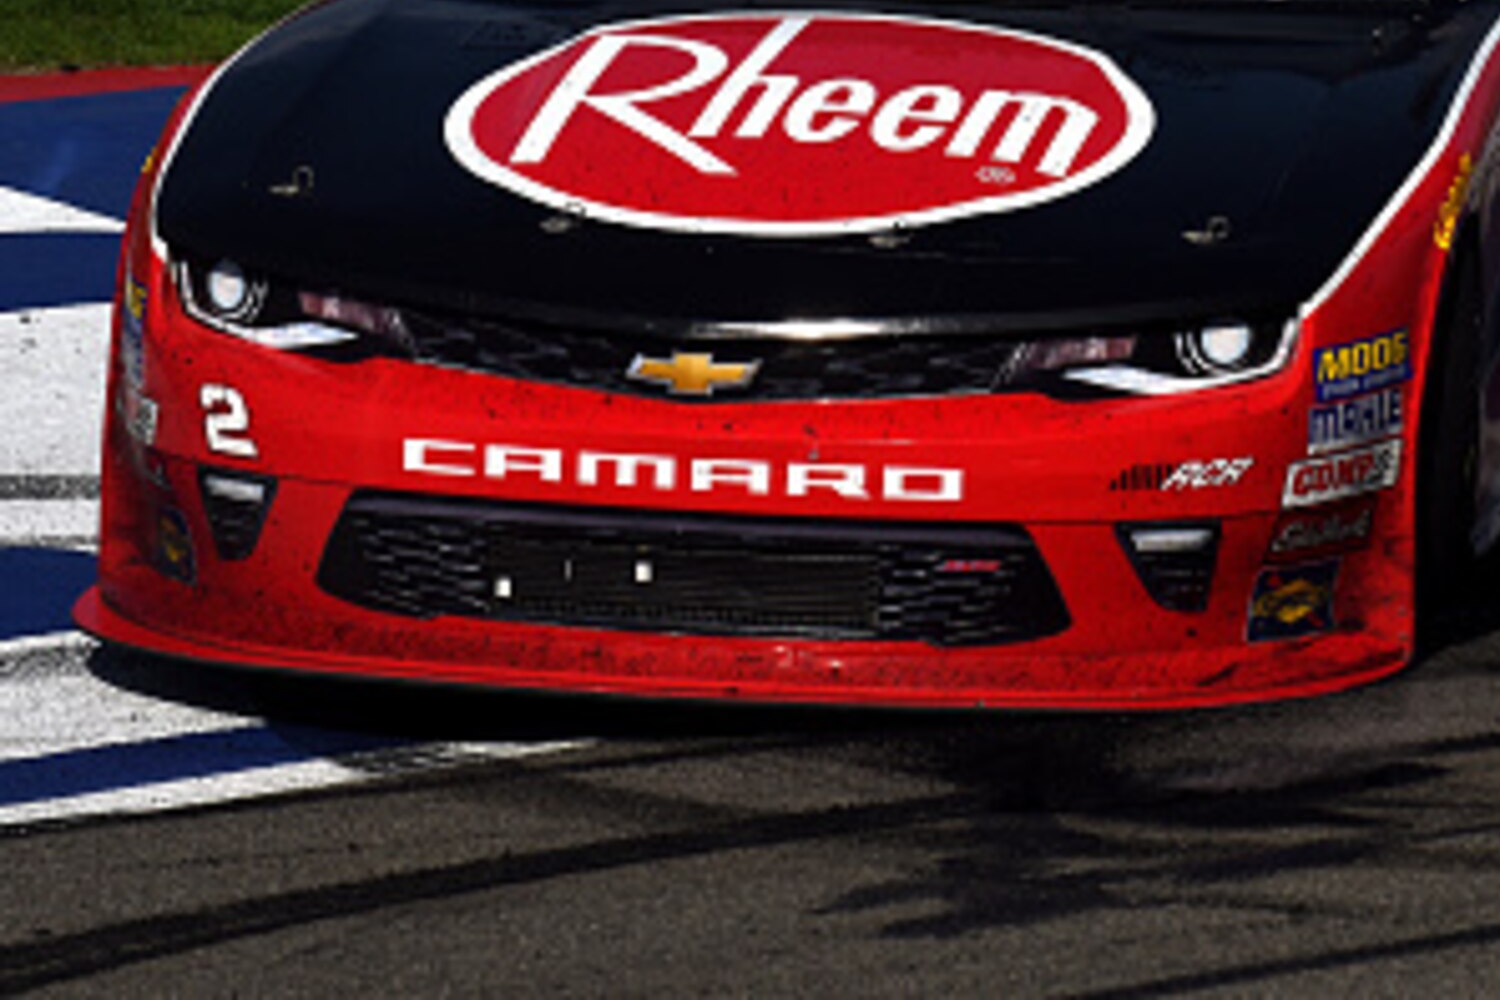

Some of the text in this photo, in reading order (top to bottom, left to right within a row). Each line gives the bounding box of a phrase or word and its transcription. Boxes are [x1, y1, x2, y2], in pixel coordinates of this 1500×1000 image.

[508, 17, 1100, 177] Rheem
[199, 382, 259, 458] 2
[402, 438, 964, 502] CAMARO
